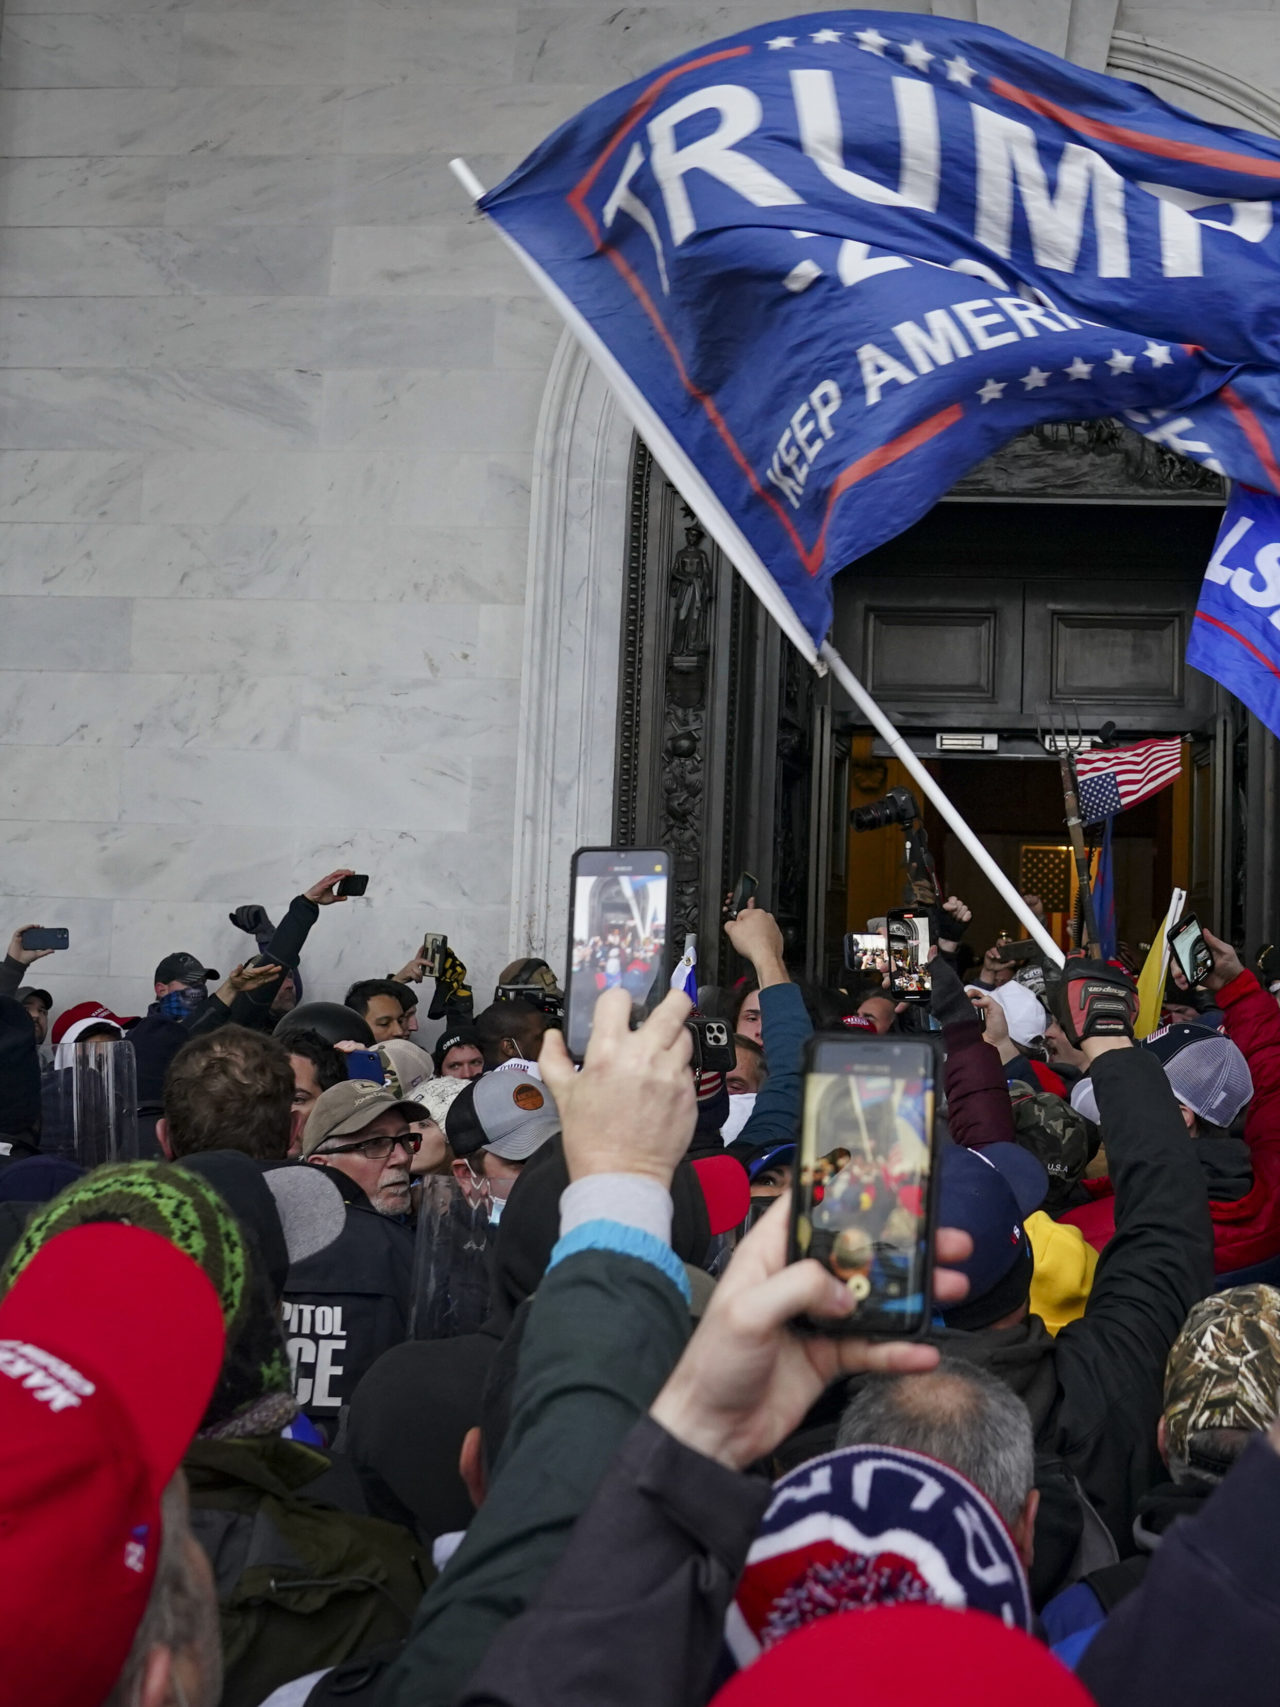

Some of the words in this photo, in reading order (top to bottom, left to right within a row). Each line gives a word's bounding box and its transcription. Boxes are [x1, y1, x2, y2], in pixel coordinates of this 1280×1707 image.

[603, 69, 1272, 295] TRUMP
[767, 379, 842, 509] KEEP
[442, 1036, 461, 1051] ORBIT
